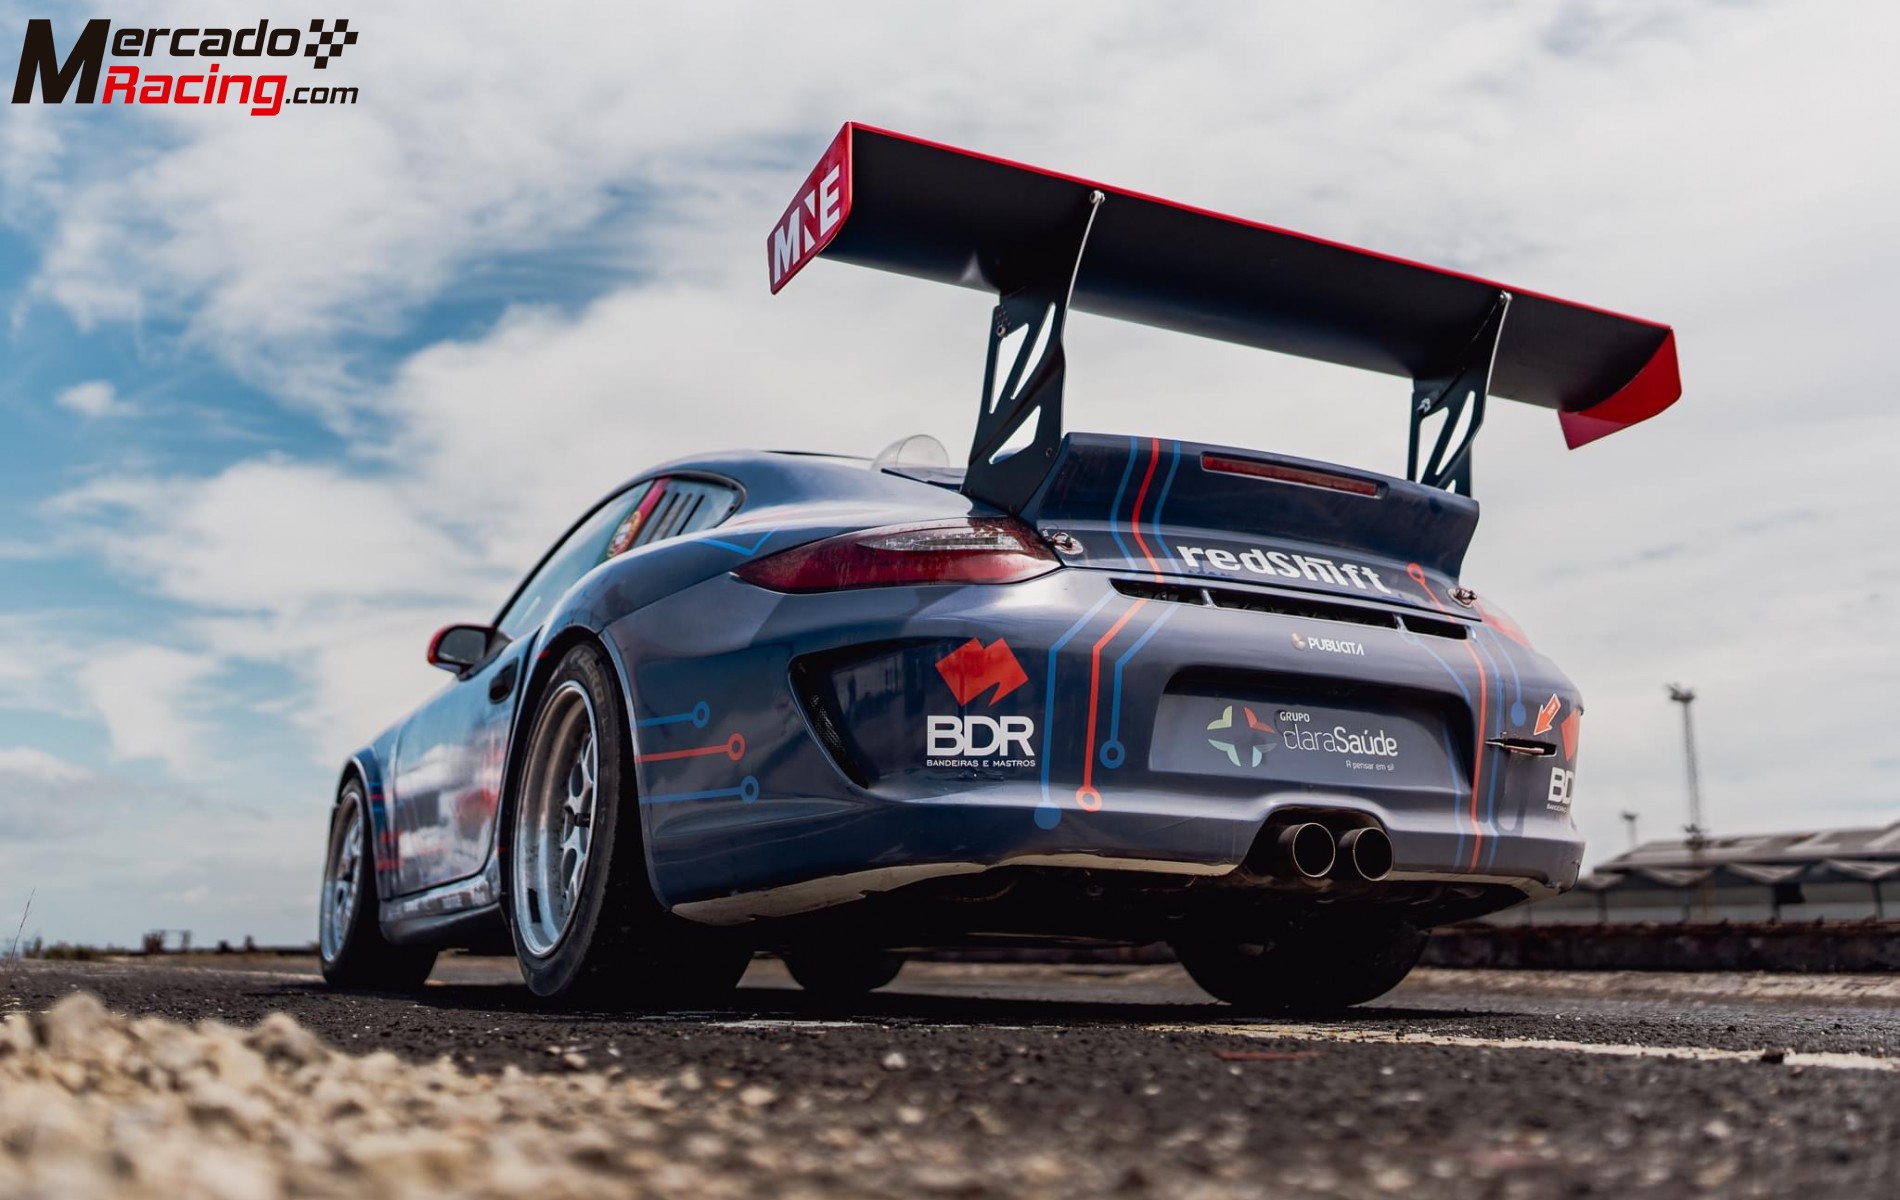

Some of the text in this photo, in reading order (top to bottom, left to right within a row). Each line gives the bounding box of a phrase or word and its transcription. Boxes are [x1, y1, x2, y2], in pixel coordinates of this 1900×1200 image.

[1279, 711, 1310, 723] GRUPO
[926, 715, 1035, 757] BDR
[1283, 723, 1399, 757] claraSaúde
[926, 759, 979, 768] BANDEIRAS
[992, 760, 1036, 768] MASTROS
